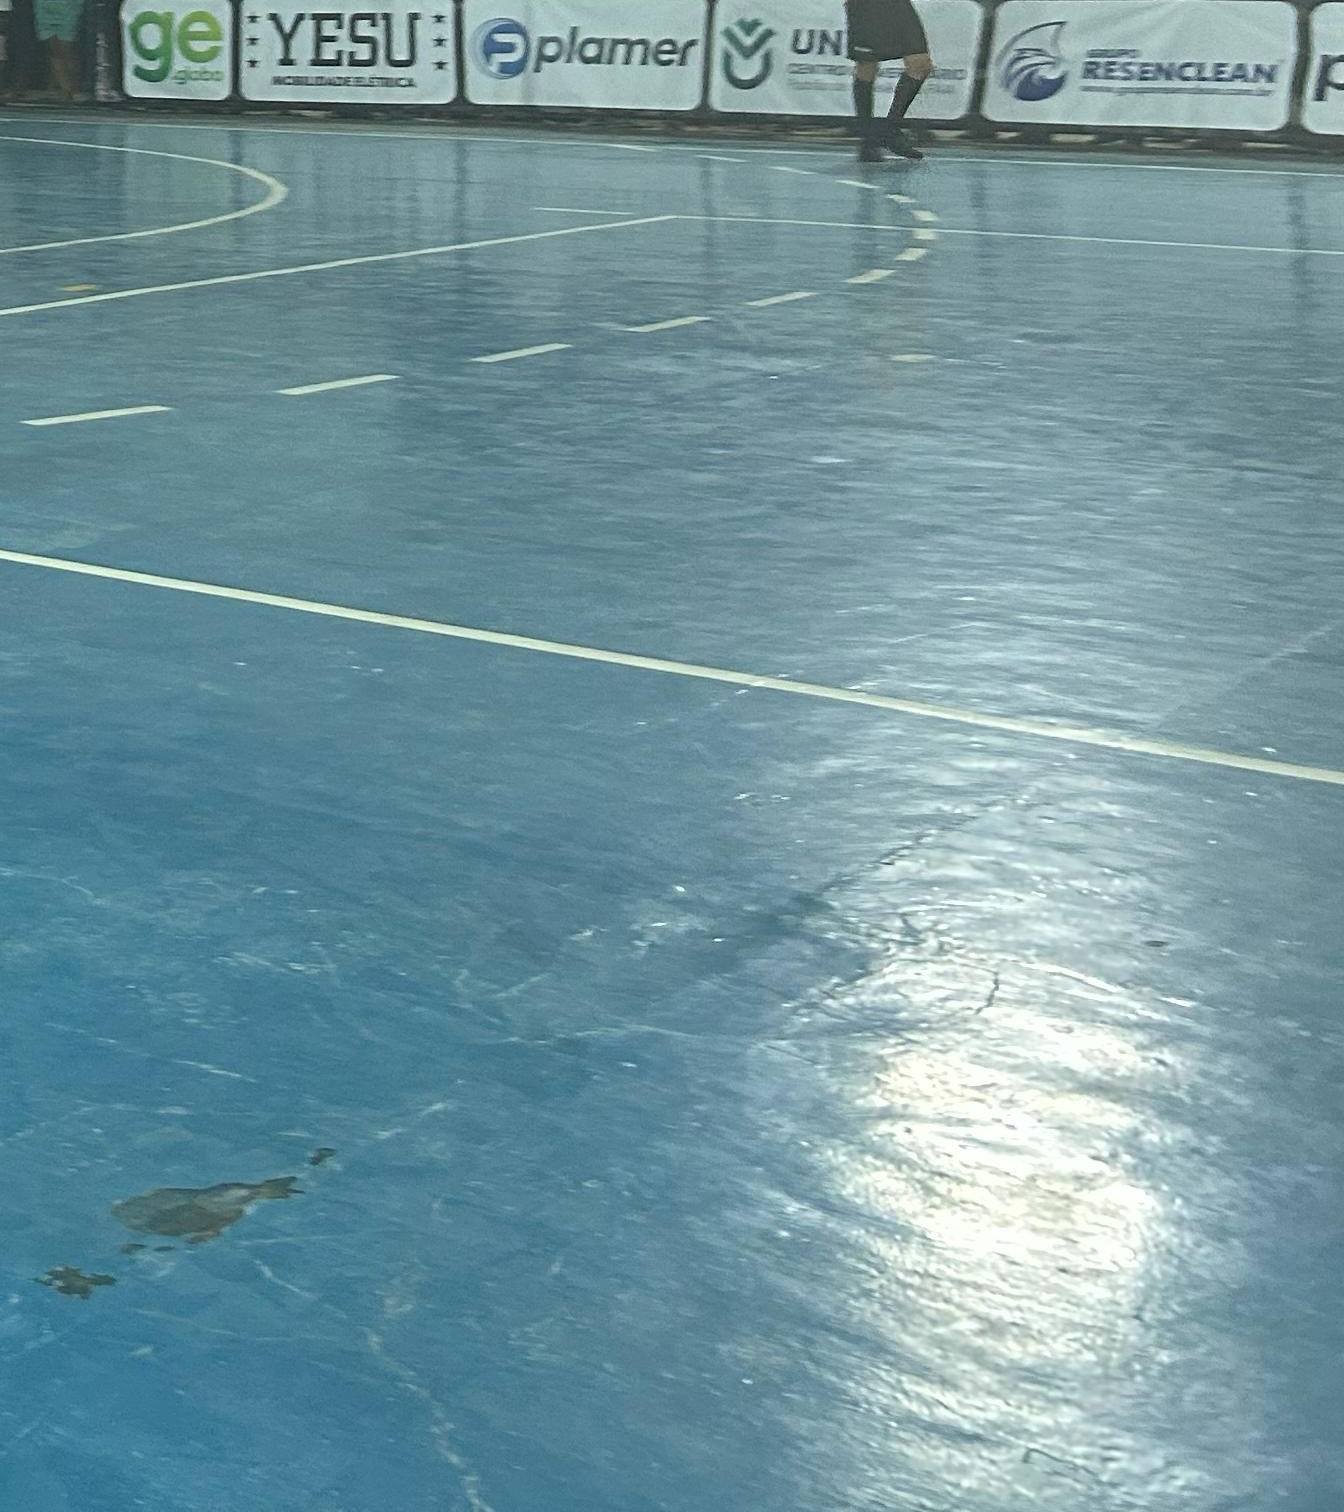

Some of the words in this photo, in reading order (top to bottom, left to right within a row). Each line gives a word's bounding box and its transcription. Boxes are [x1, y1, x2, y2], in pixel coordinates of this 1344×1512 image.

[129, 10, 224, 83] ge
[267, 12, 422, 67] YESU
[533, 25, 699, 73] plamer
[1082, 60, 1279, 83] RESENCLEAN
